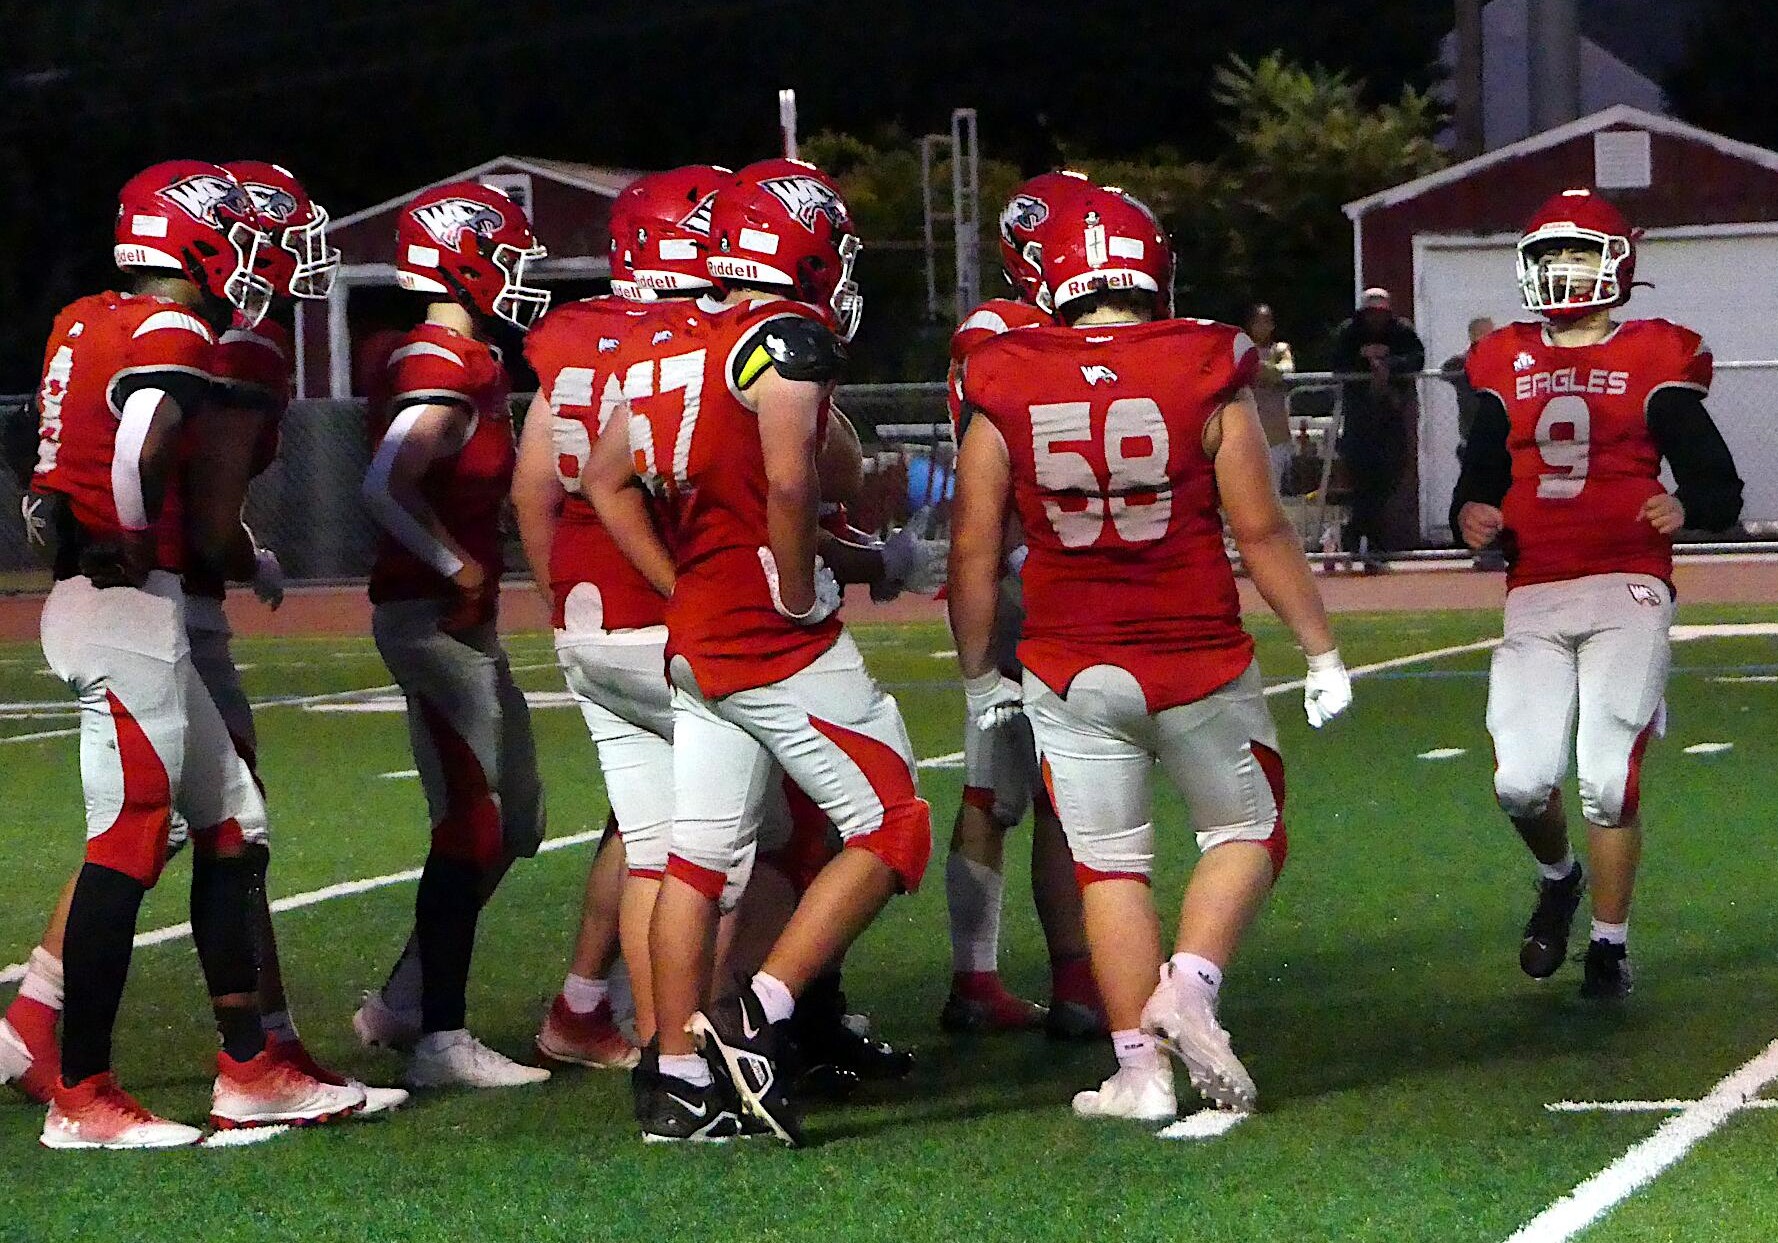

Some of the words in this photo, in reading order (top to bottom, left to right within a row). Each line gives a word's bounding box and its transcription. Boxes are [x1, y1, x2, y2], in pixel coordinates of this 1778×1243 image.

[623, 348, 708, 497] 67
[1515, 366, 1630, 400] EAGLES
[1029, 398, 1173, 548] 58
[1535, 395, 1591, 499] 9
